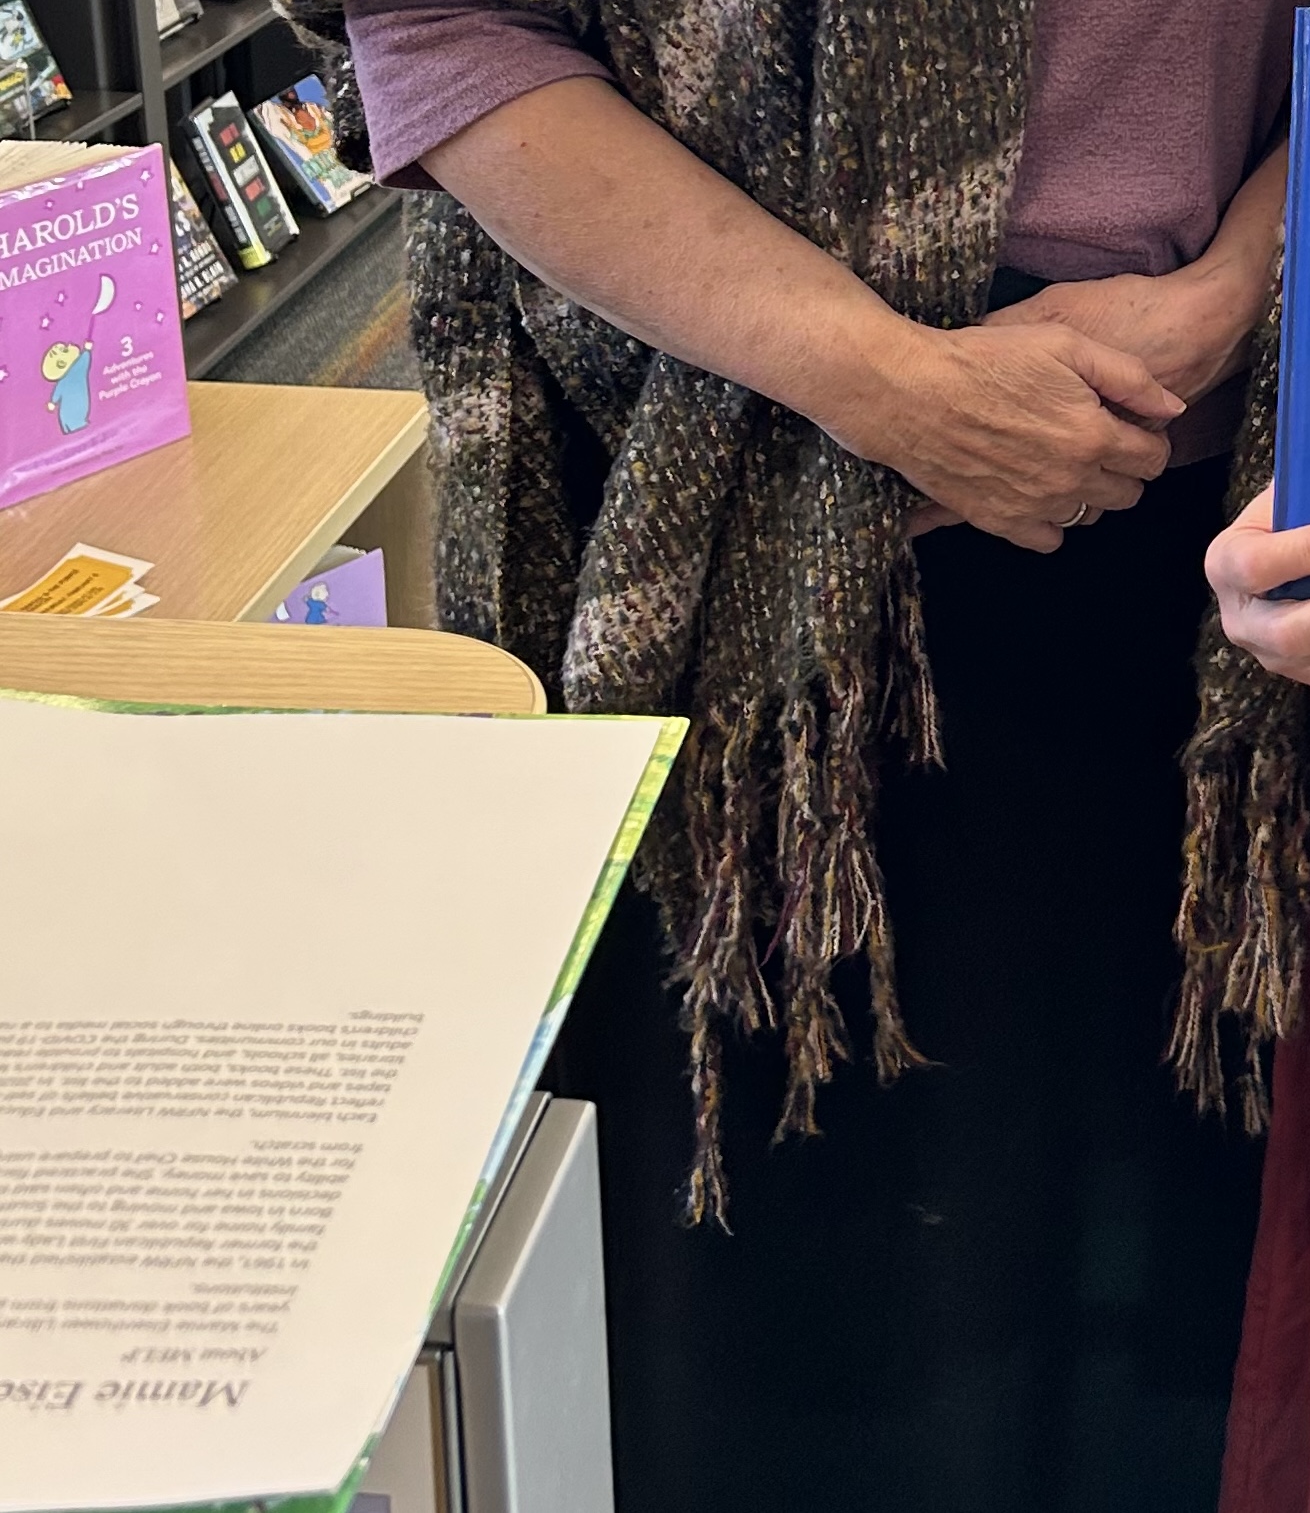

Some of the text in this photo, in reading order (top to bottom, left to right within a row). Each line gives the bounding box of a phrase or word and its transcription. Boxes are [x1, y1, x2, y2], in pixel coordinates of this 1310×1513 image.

[120, 336, 133, 357] 3
[103, 351, 154, 375] Adventures
[111, 364, 148, 384] with the
[98, 371, 162, 401] Purple Crayon
[56, 1021, 109, 1031] media
[109, 1022, 159, 1031] social
[160, 1020, 230, 1032] through
[231, 1023, 285, 1033] online
[287, 1025, 338, 1035] books
[131, 1033, 190, 1045] During
[361, 1040, 414, 1051] adults
[35, 1046, 101, 1058] provide
[124, 1048, 200, 1059] hospitals
[202, 1049, 237, 1059] and
[134, 1063, 178, 1074] adult
[180, 1064, 221, 1074] both
[283, 1066, 332, 1078] These
[145, 1078, 202, 1088] added
[203, 1079, 247, 1087] were
[251, 1080, 305, 1091] videos
[121, 1092, 229, 1101] conservative
[233, 1094, 327, 1107] Republican
[331, 1097, 385, 1108] reflect
[337, 1112, 378, 1124] Each
[320, 1142, 363, 1154] from
[110, 1199, 180, 1214] moving
[114, 1237, 216, 1250] Republican
[199, 1347, 269, 1365] About
[93, 1379, 251, 1411] Mamie
